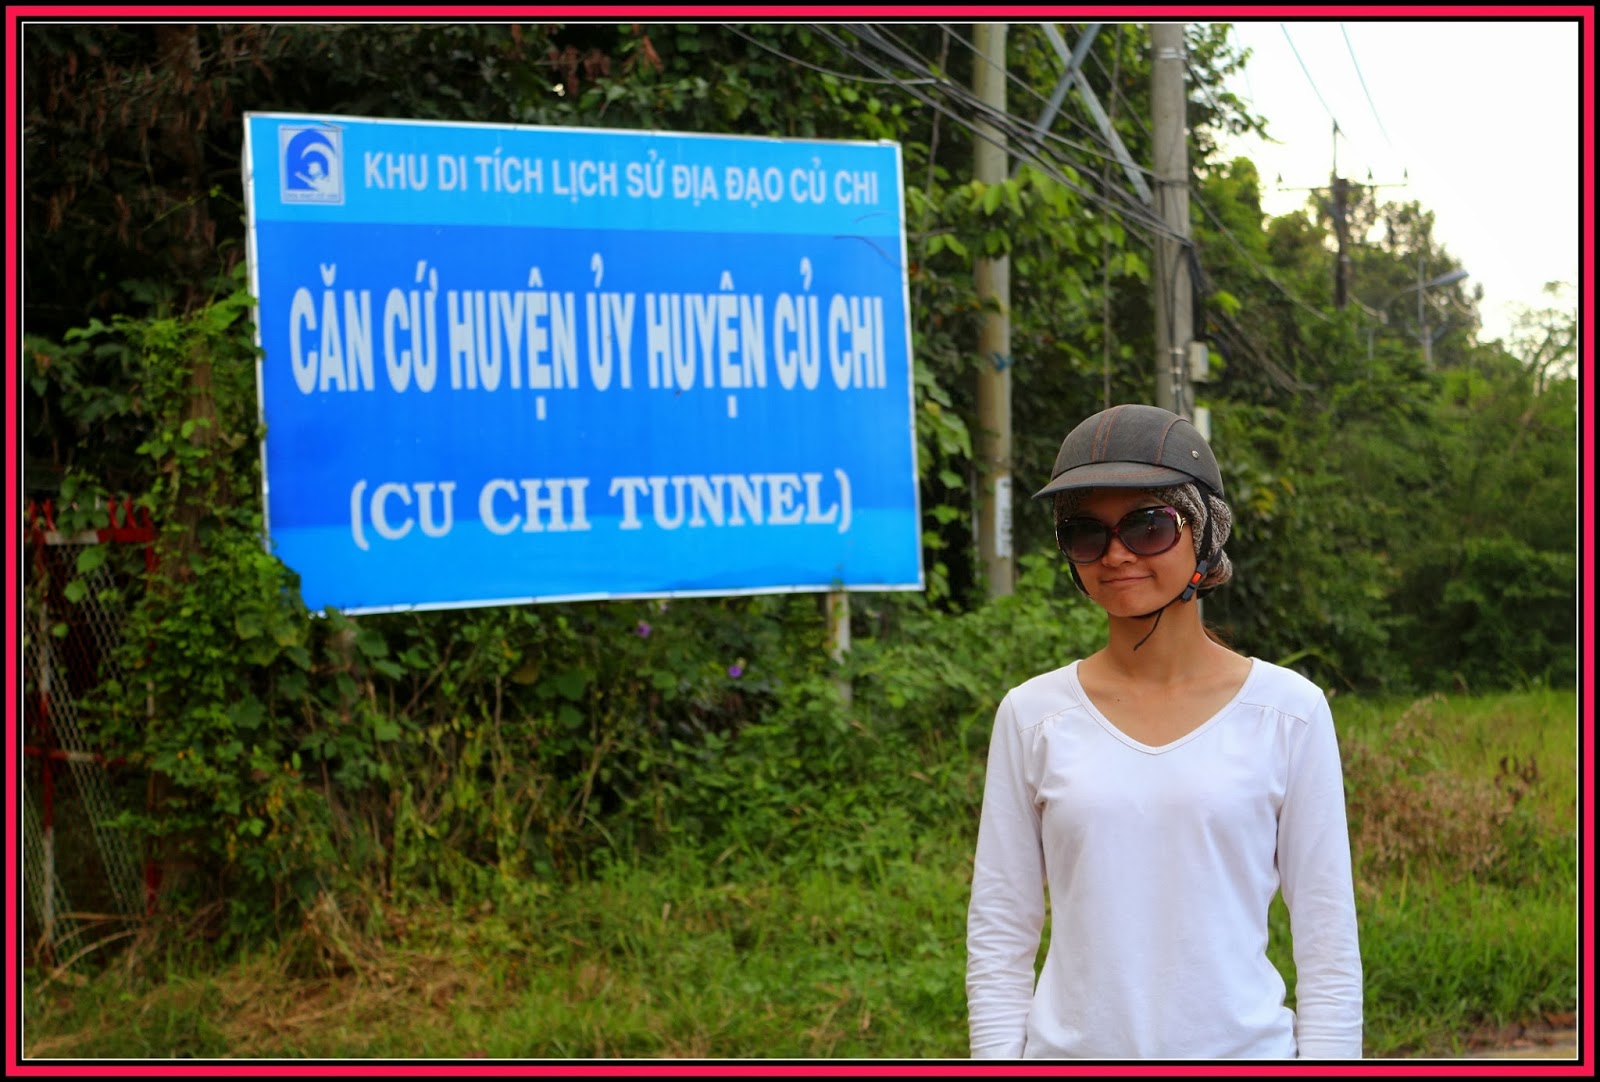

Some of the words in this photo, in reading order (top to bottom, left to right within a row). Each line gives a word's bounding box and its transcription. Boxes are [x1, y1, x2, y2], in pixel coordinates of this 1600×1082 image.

[365, 152, 427, 190] KHU
[438, 155, 467, 190] DI
[475, 148, 542, 193] TÍCH
[553, 160, 617, 201] LỊCH
[627, 150, 664, 198] SỬ
[673, 165, 718, 205] ĐỊA
[725, 167, 783, 207] ĐẠO
[790, 157, 826, 204] CỦ
[834, 170, 878, 204] CHI
[290, 264, 373, 394] CĂN
[384, 261, 437, 392] CỨ
[448, 267, 578, 419] HUYỆN
[587, 254, 635, 390] ỦY
[646, 272, 766, 417] HUYỆN
[774, 258, 820, 389] CỦ
[829, 294, 886, 390] CHI
[351, 481, 455, 550] (CU
[480, 478, 590, 534] CHI
[610, 469, 851, 532] TUNNEL)
